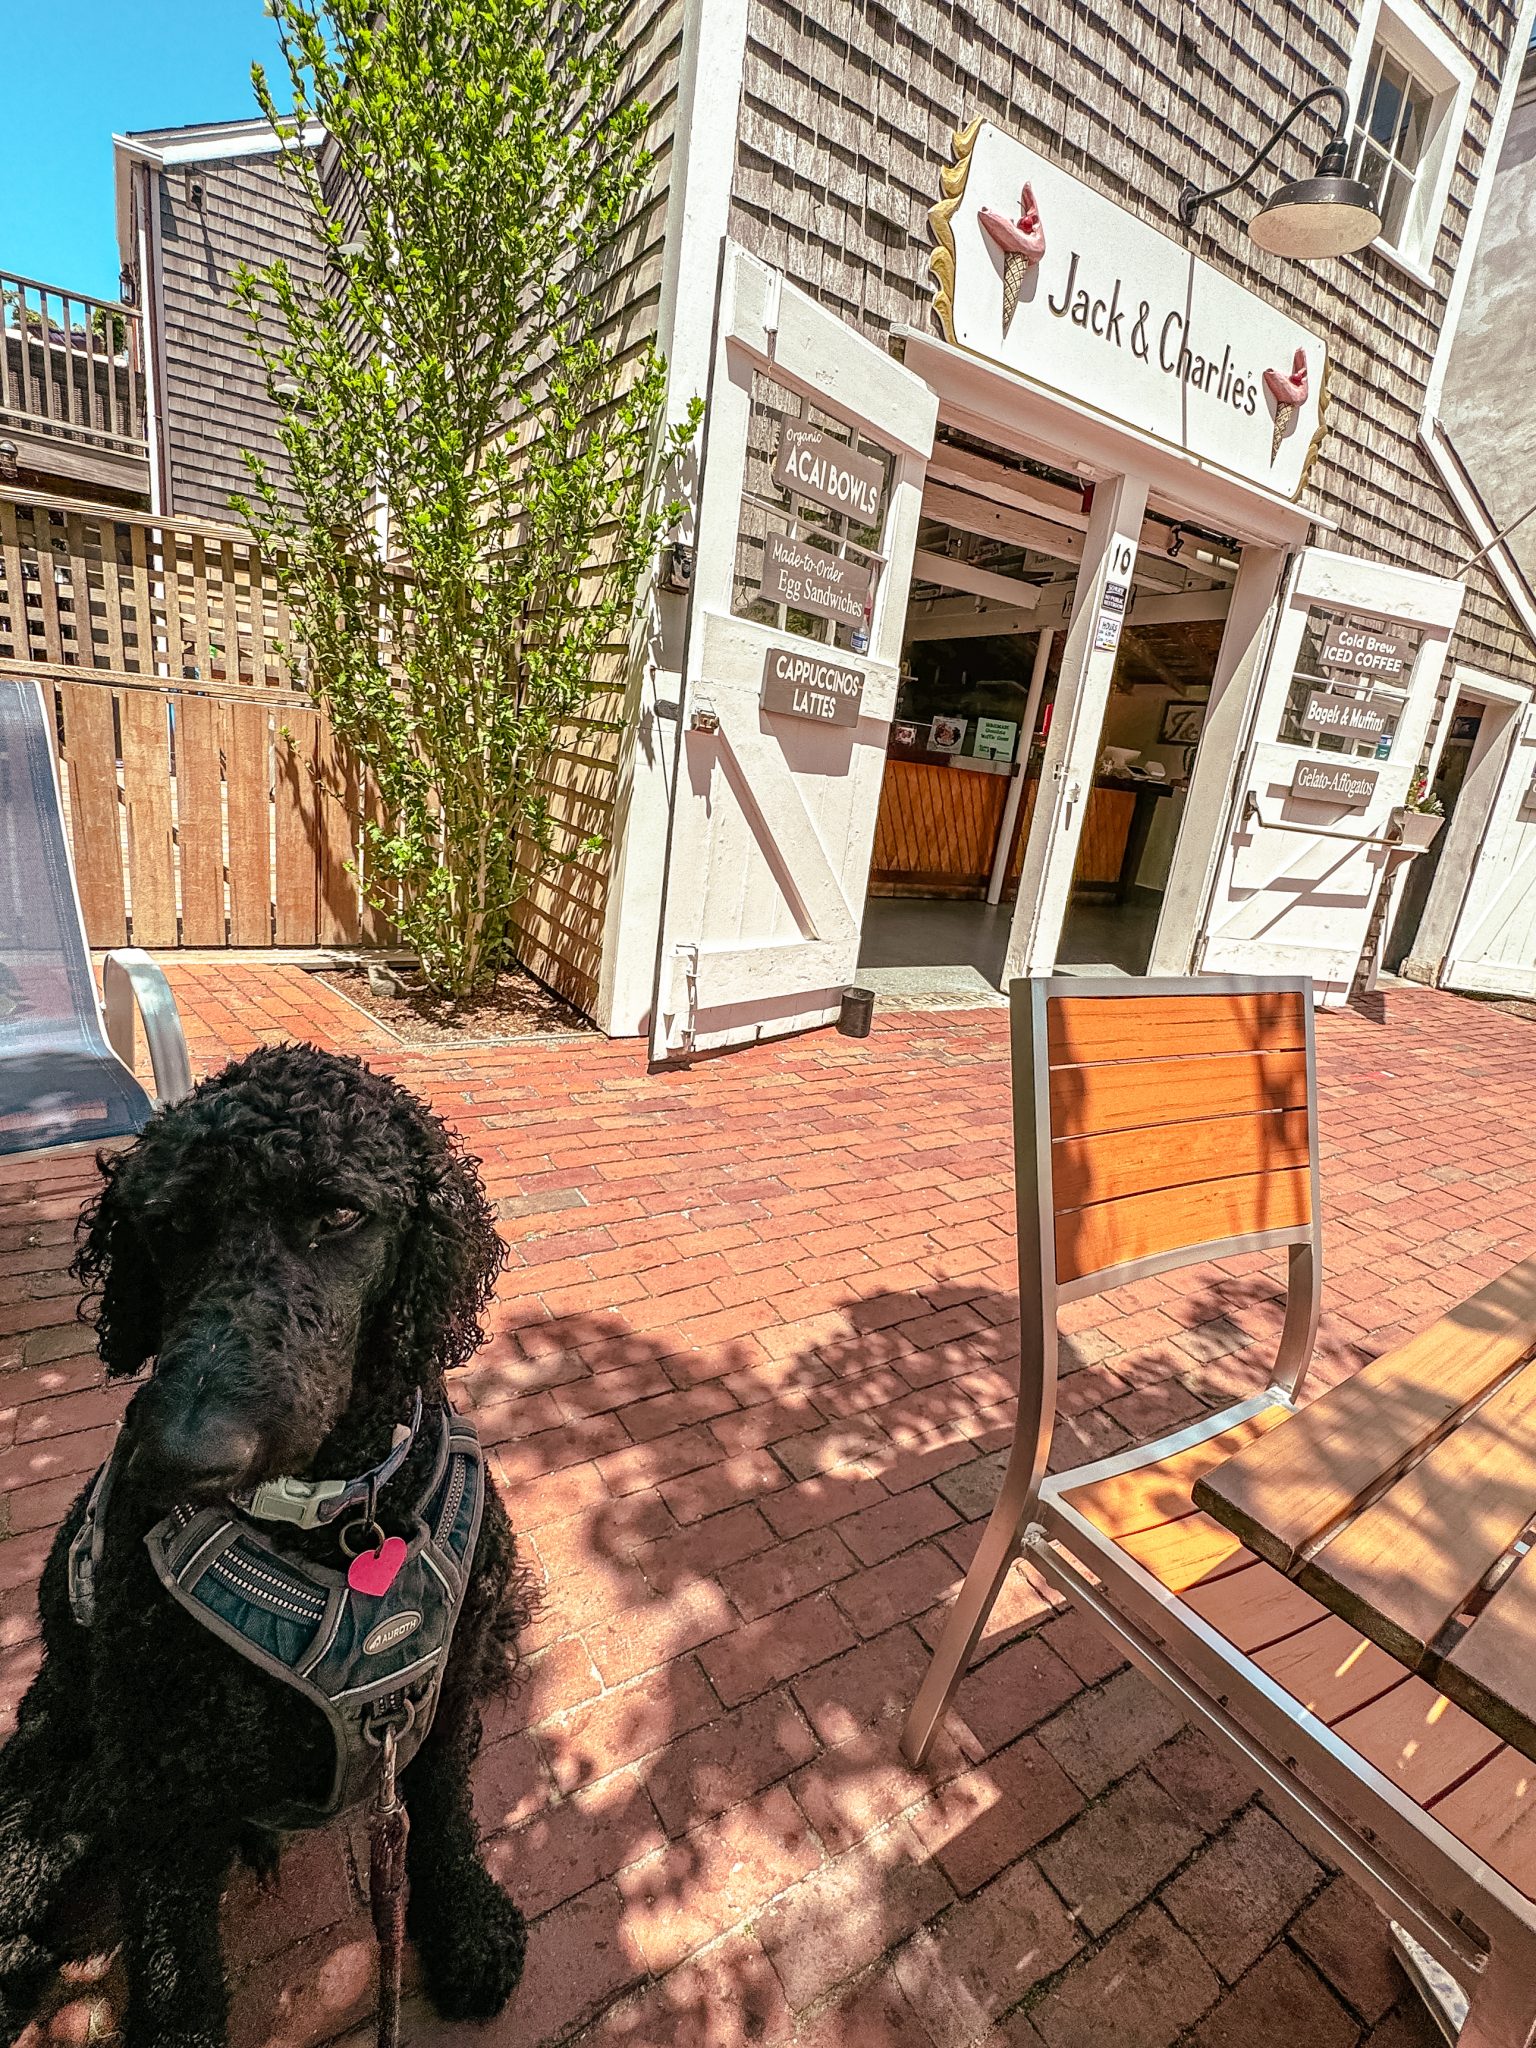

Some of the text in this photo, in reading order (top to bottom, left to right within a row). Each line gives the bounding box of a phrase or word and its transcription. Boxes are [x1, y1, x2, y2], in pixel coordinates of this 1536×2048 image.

[1048, 251, 1258, 416] Jack & Charlie's
[786, 428, 823, 447] Organic
[785, 445, 878, 515] ACAI BOWLS
[772, 540, 844, 584] Made-to-Order
[1112, 543, 1132, 576] 10
[777, 568, 864, 618] Egg Sandwiches
[1323, 645, 1403, 673] ICED COFFEE
[1338, 631, 1398, 655] Cold Brew
[776, 655, 860, 697] CAPPUCCINOS
[792, 688, 837, 719] LATTES
[1307, 700, 1385, 732] Bagels & Muffins
[1298, 766, 1375, 797] Gelato-Affogatos
[381, 1619, 417, 1644] AUROTH
